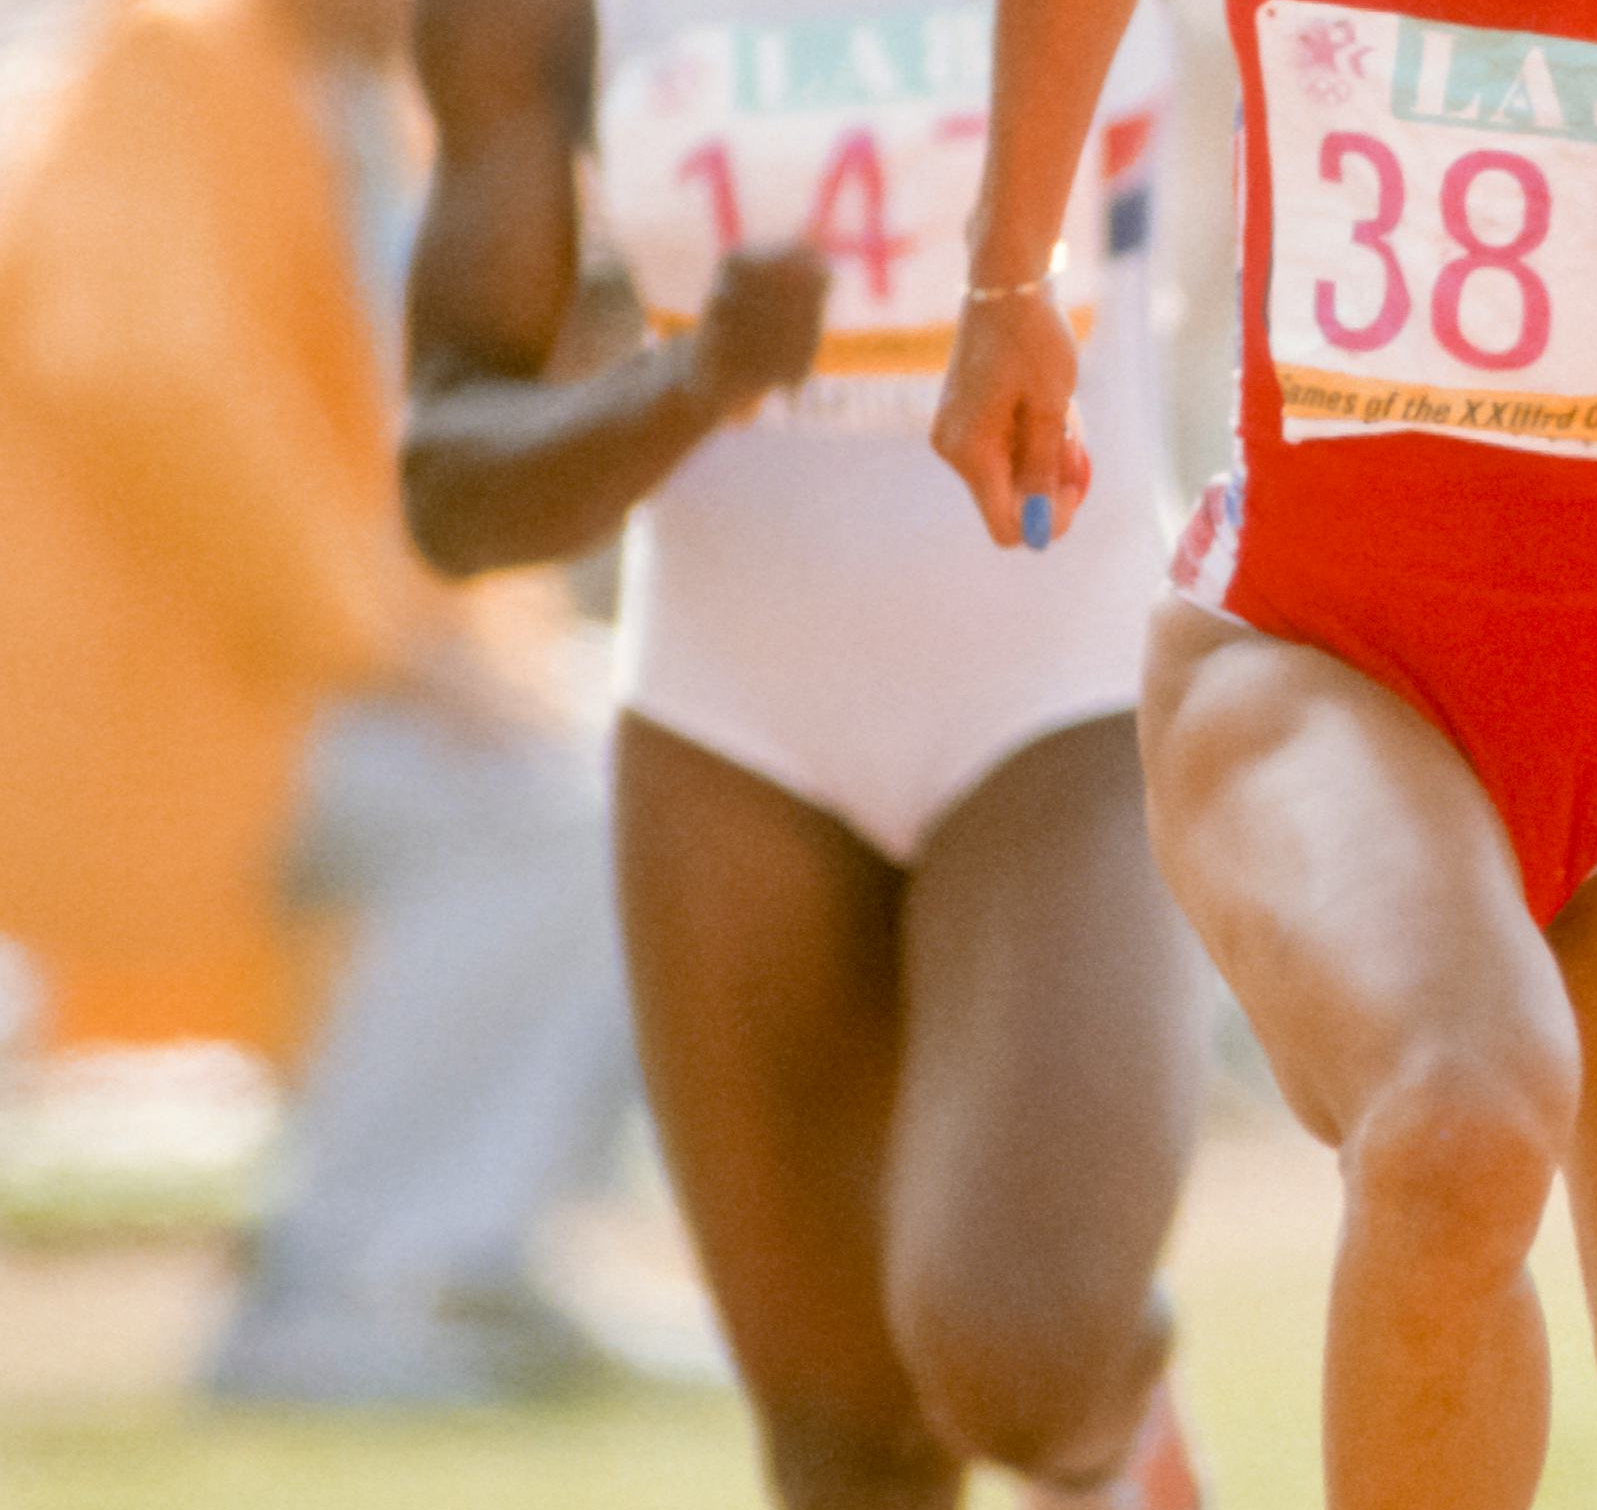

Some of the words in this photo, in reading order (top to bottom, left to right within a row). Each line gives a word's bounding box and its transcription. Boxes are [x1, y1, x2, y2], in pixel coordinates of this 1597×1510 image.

[1410, 29, 1566, 131] LA
[678, 117, 988, 301] 14
[1281, 377, 1358, 416] ames
[1363, 392, 1399, 424] of
[1402, 395, 1451, 424] the
